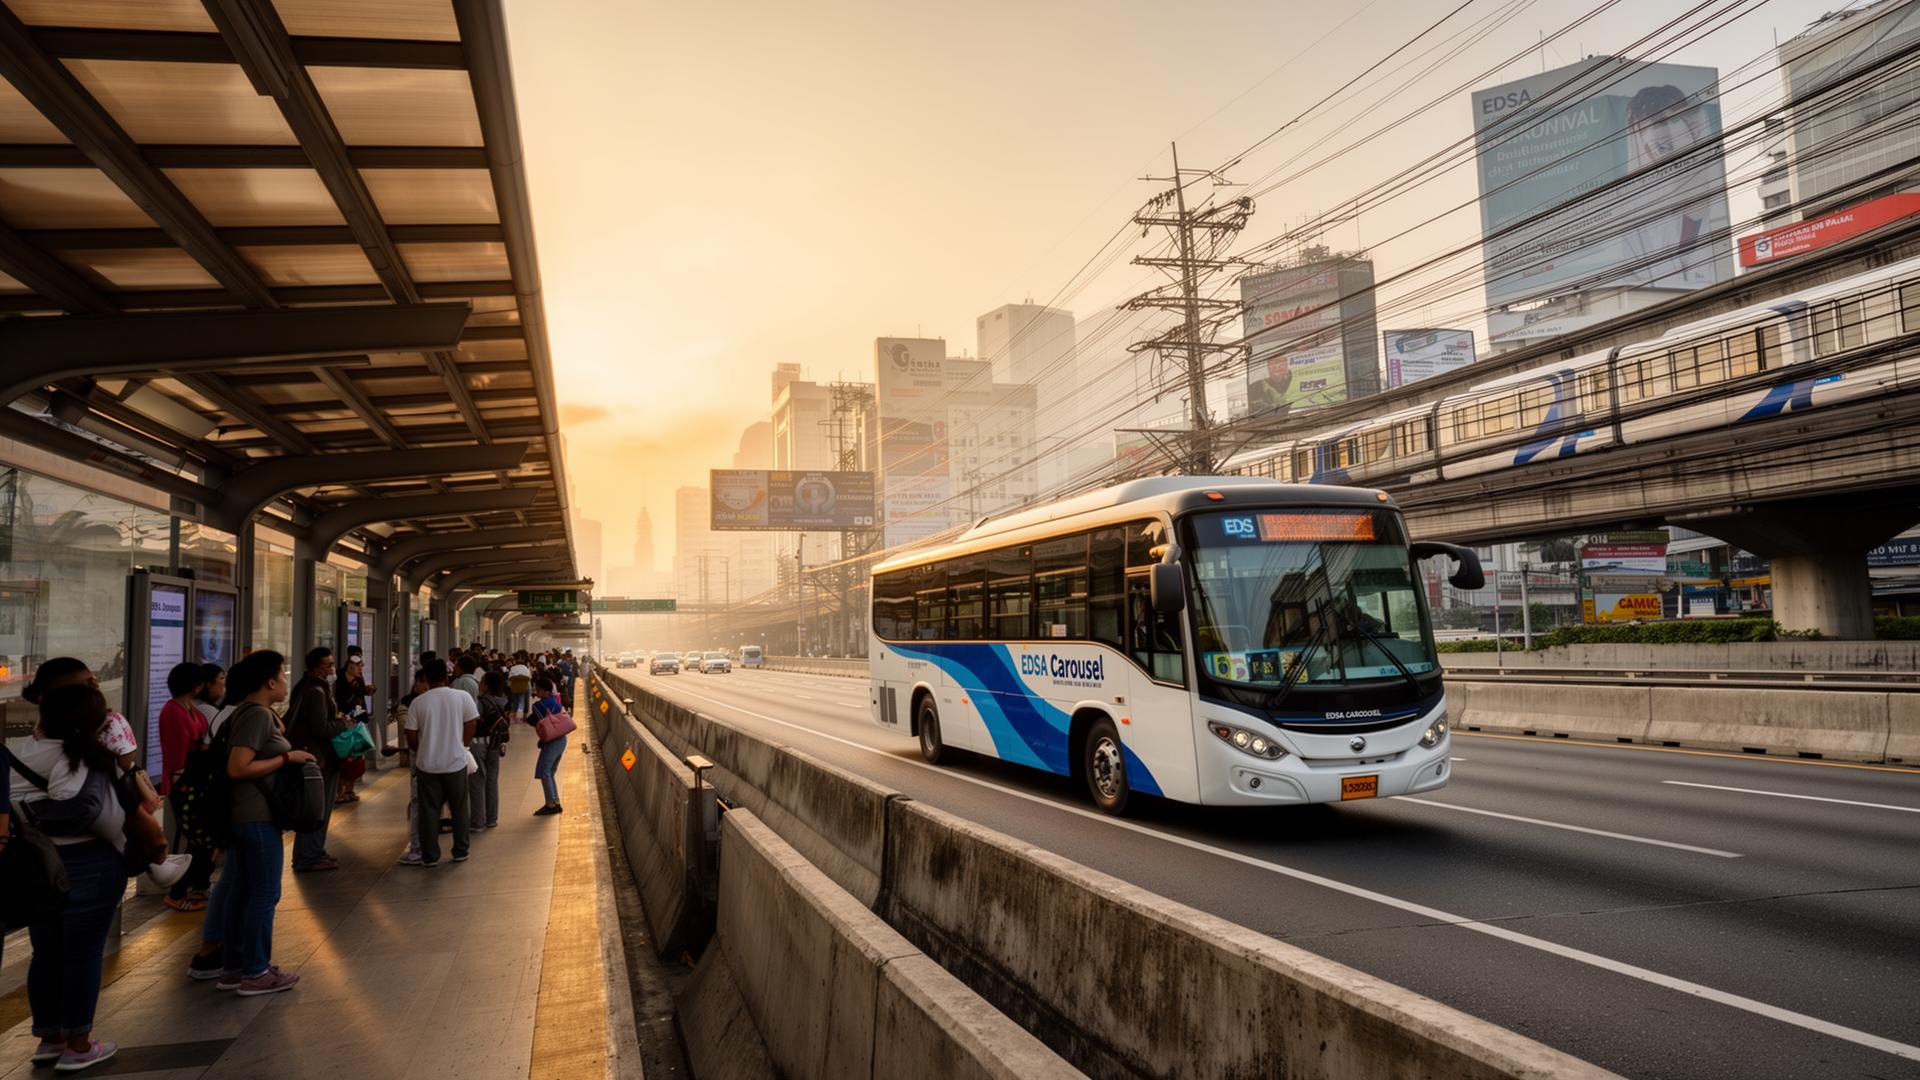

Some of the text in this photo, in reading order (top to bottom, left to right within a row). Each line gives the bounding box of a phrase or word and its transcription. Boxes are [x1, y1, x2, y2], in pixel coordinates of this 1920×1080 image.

[1482, 89, 1531, 115] EDSA
[1224, 518, 1254, 534] EDS
[1021, 654, 1104, 680] EDSA Carousel
[1325, 711, 1345, 720] EDSA
